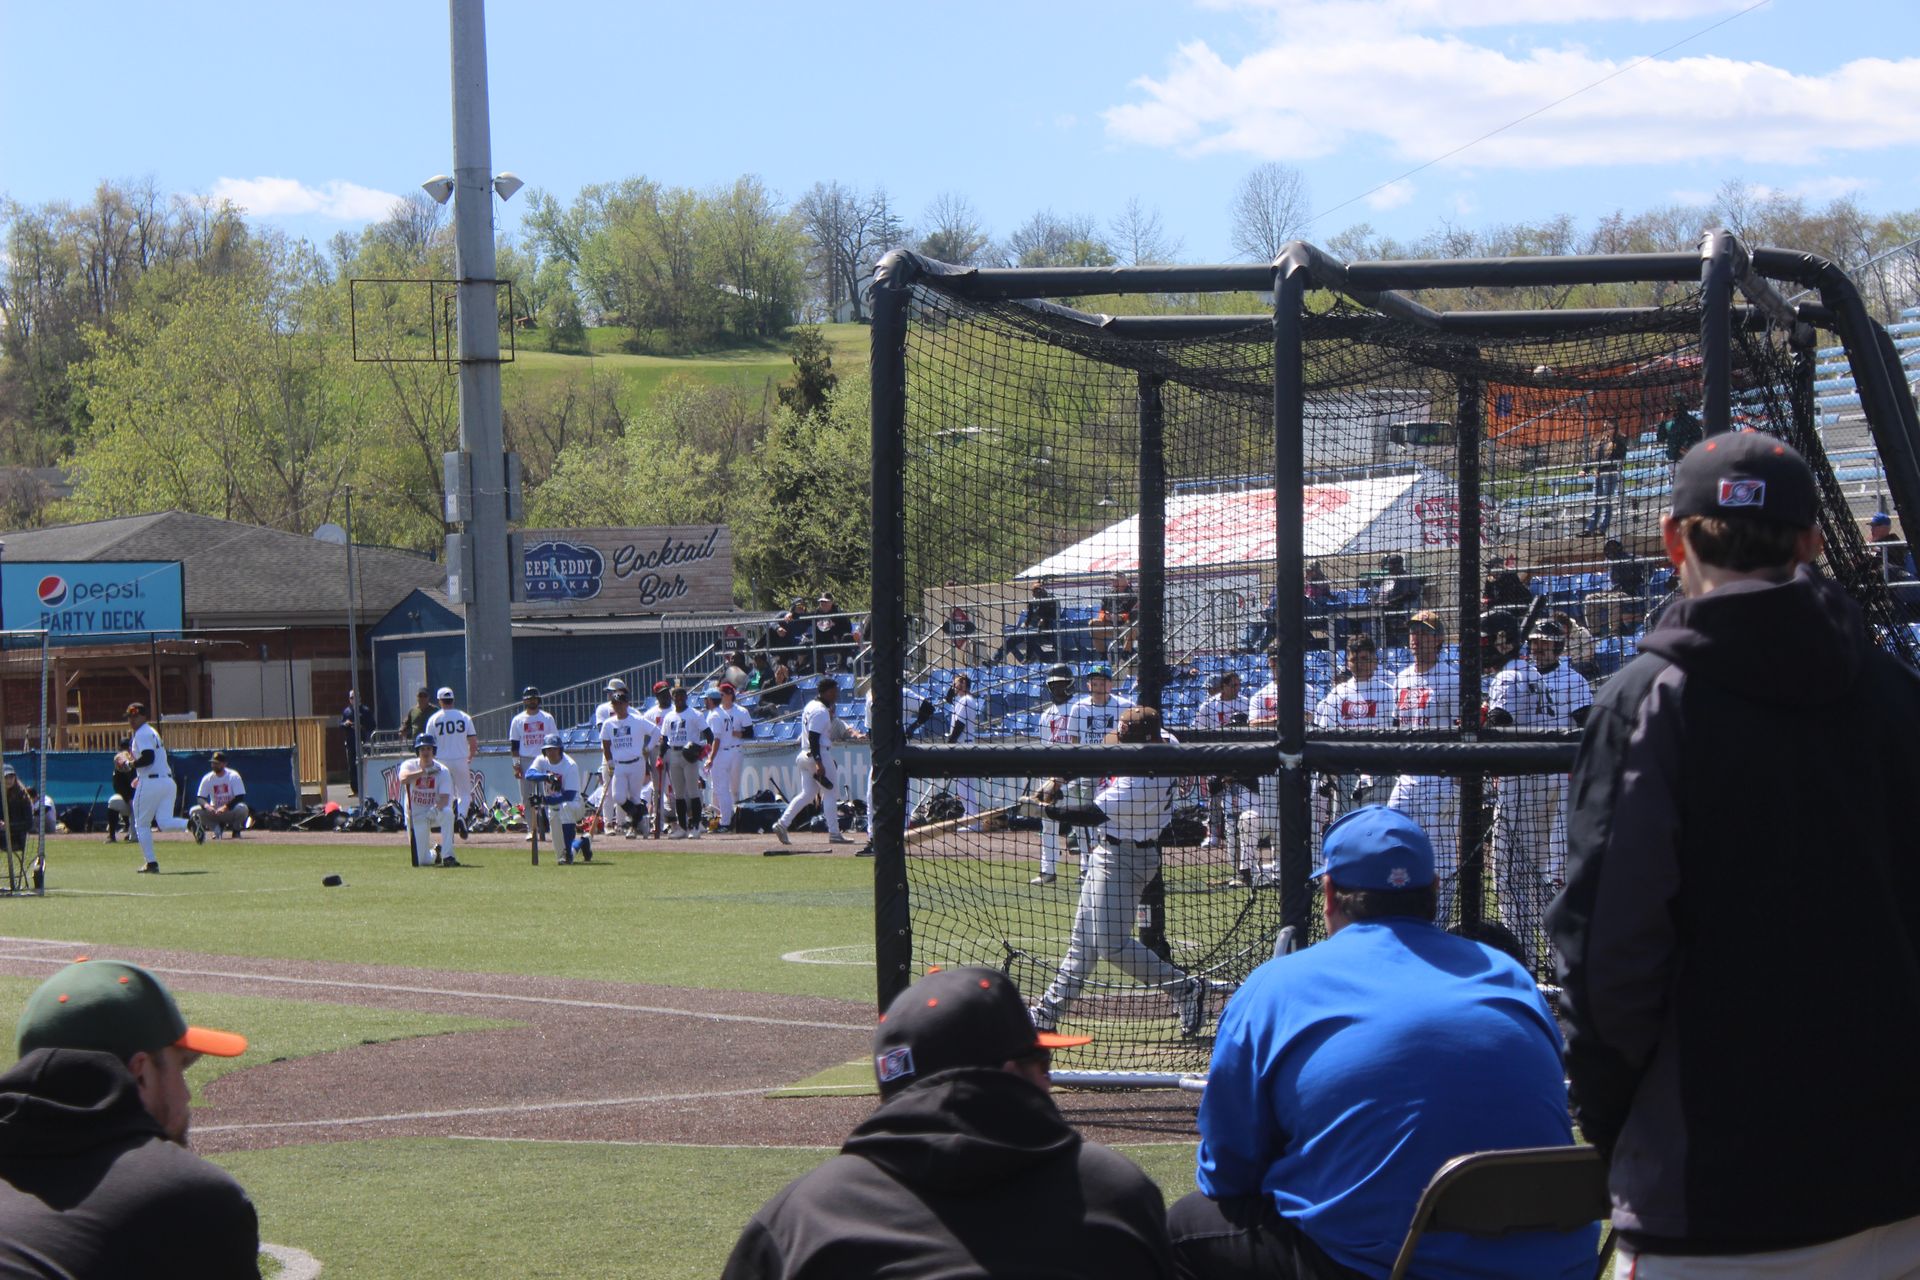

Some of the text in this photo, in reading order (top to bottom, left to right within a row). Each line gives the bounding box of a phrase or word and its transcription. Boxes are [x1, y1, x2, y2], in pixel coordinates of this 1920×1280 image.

[613, 528, 719, 579] Cocktail
[525, 559, 593, 577] EEP EDDY
[73, 578, 140, 604] pepsi
[525, 581, 590, 591] VODKA
[638, 573, 688, 606] Bar
[40, 610, 146, 631] PARTY DECK
[435, 719, 466, 736] 703
